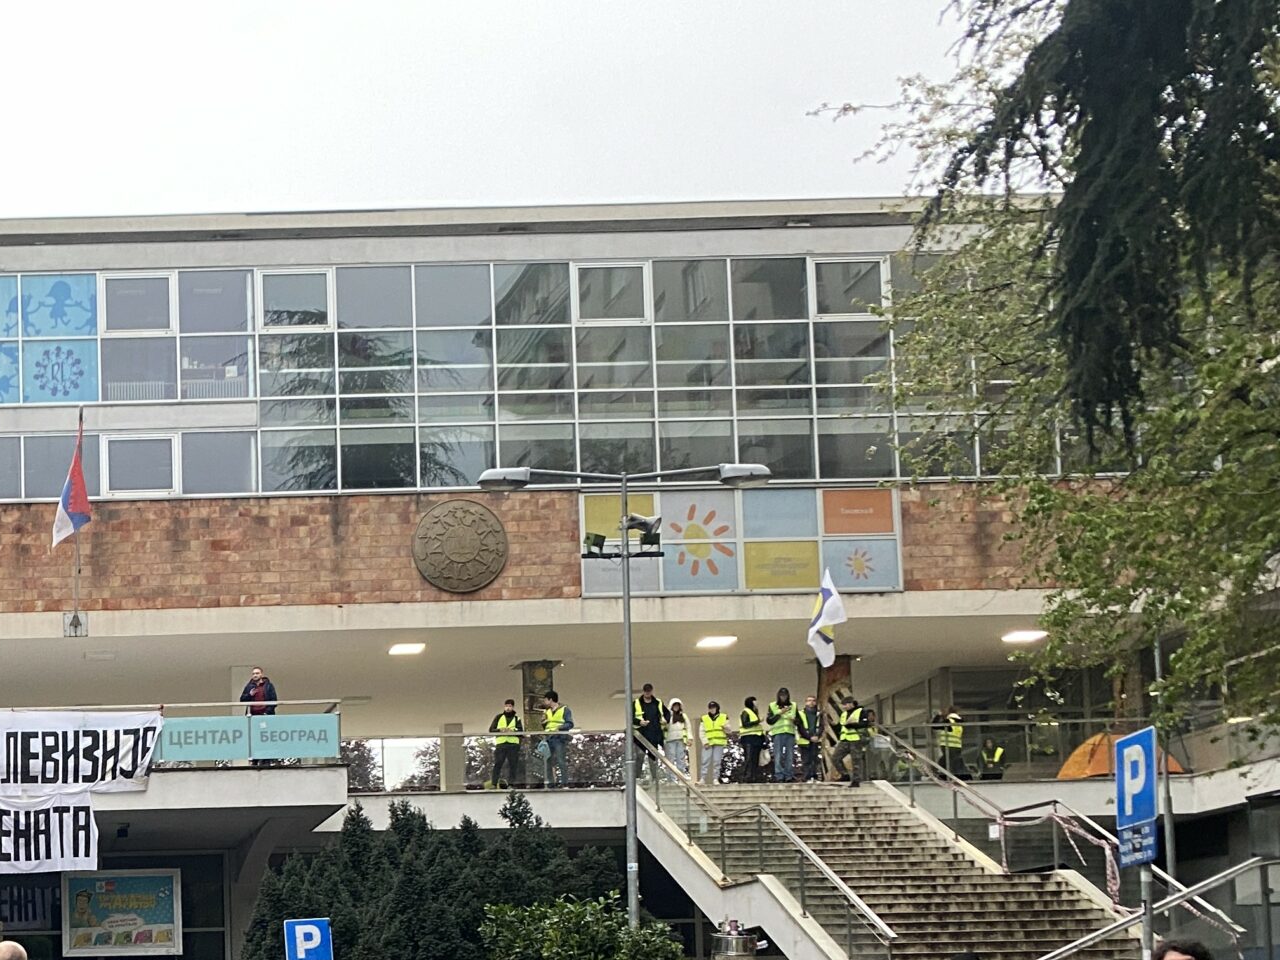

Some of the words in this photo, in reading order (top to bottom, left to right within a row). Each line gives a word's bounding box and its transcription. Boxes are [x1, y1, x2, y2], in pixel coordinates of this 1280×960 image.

[169, 729, 243, 748] ЦЕНТАР
[260, 729, 329, 743] БЕОГРАД
[1123, 744, 1146, 816] P
[295, 924, 322, 960] P
